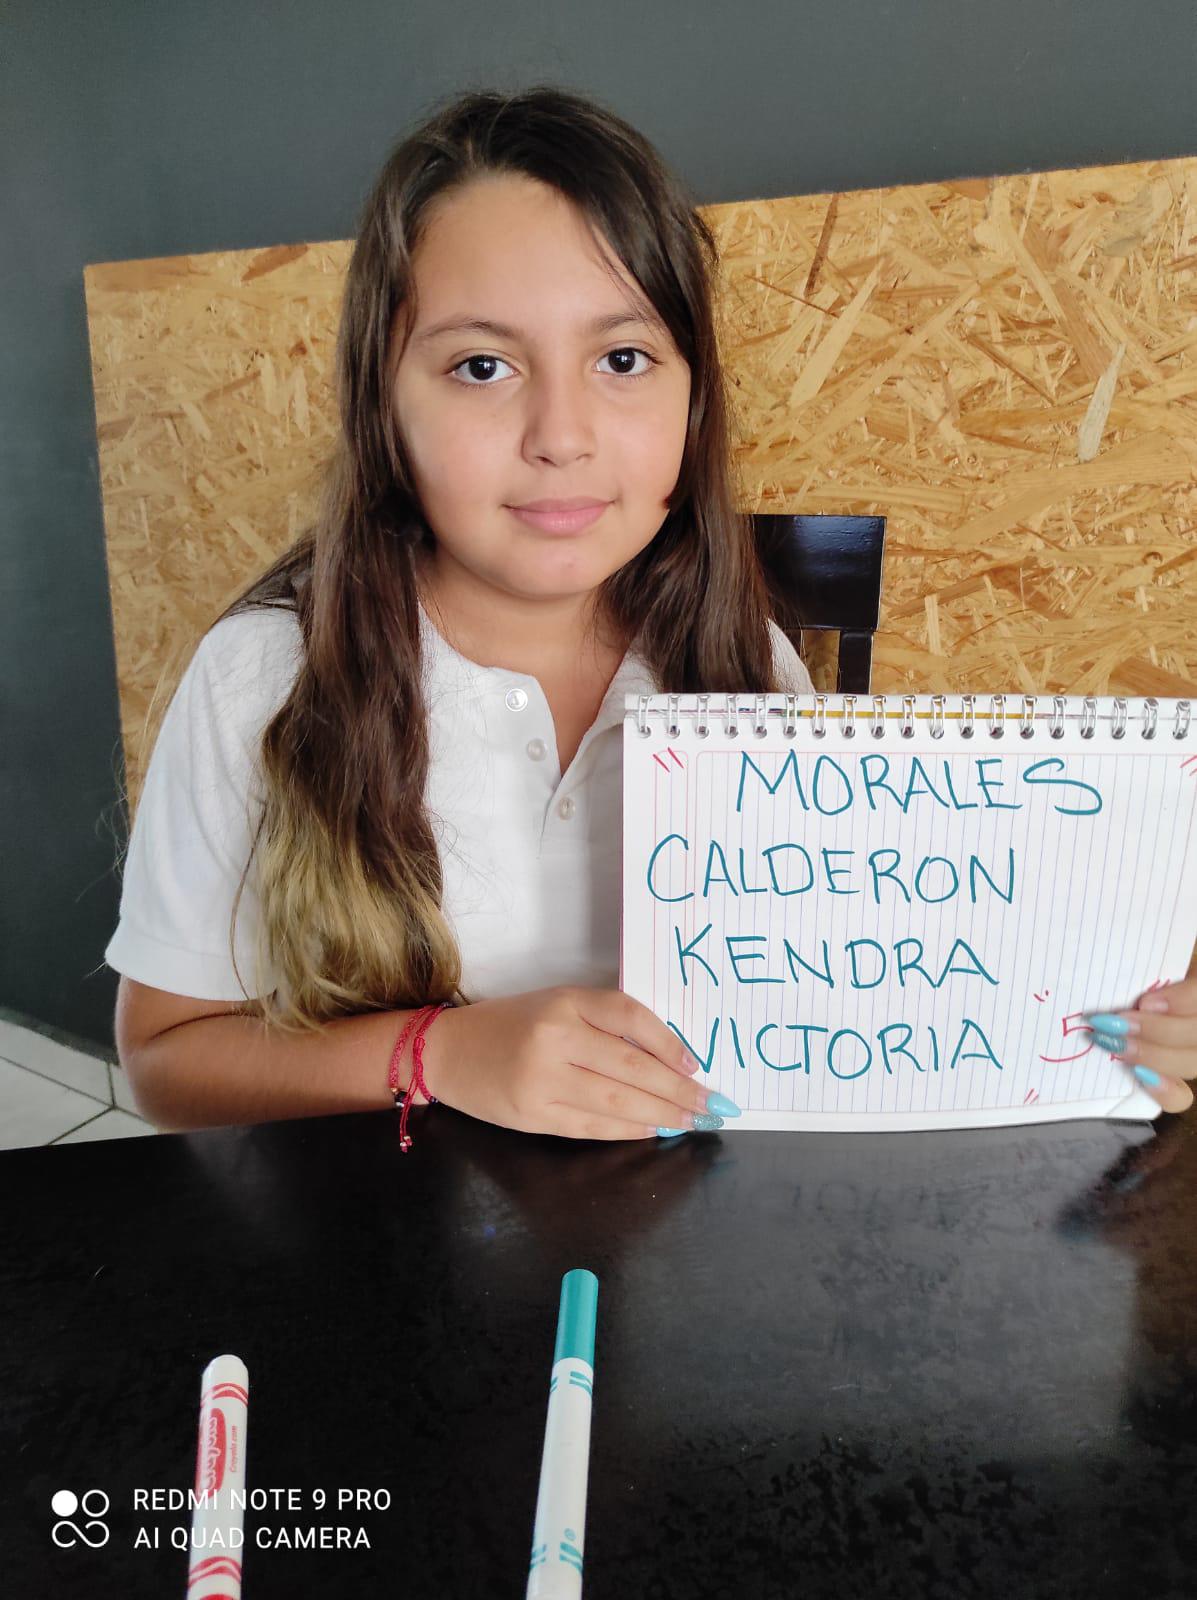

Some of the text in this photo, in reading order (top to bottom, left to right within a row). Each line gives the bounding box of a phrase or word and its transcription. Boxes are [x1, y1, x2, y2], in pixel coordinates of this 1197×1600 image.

[737, 750, 1103, 816] MORALES
[646, 834, 1015, 904] CALDERON
[674, 923, 999, 989] KENDRA
[666, 1016, 1003, 1080] VICTORIA
